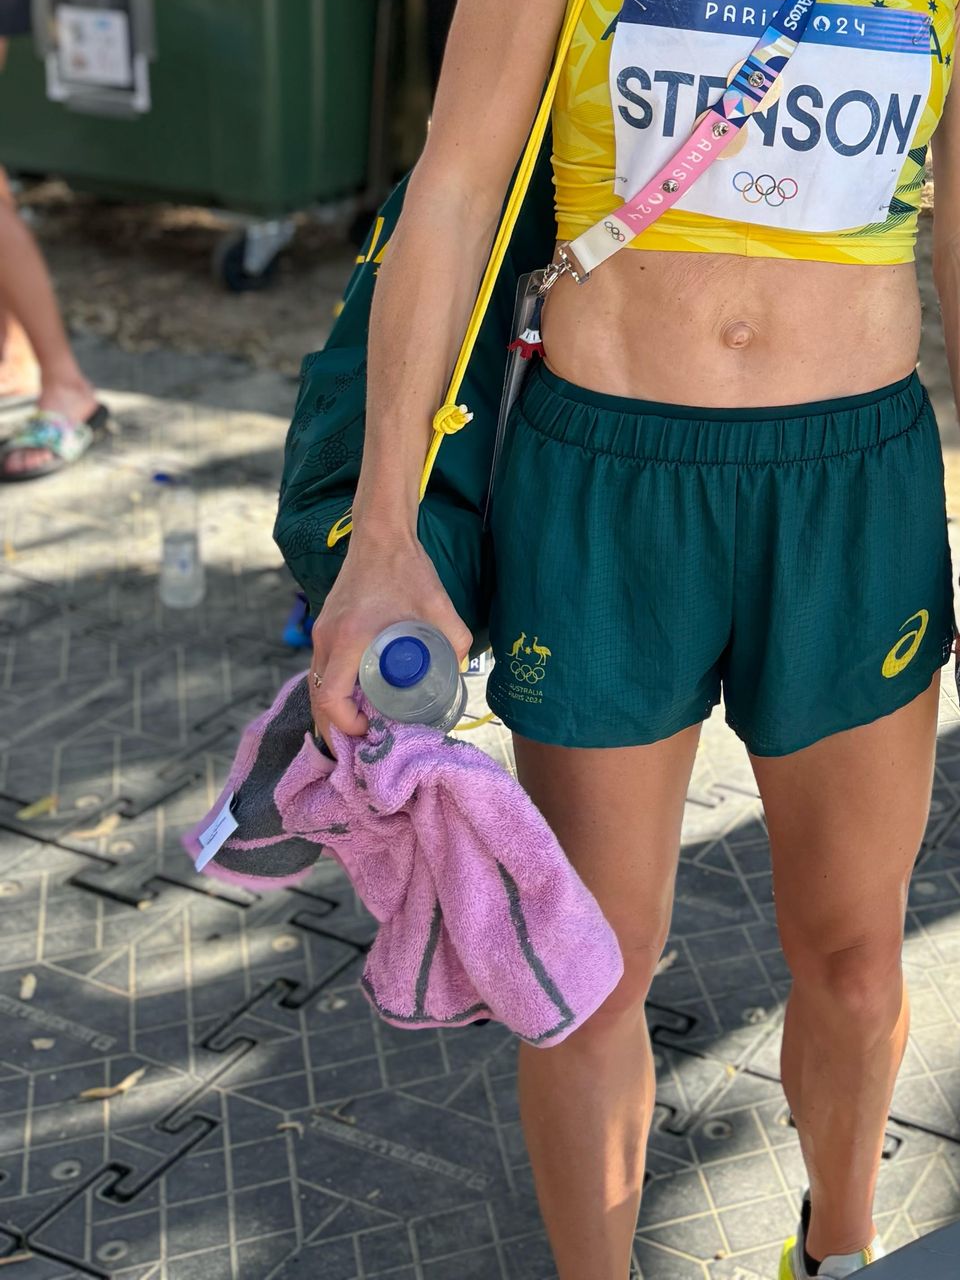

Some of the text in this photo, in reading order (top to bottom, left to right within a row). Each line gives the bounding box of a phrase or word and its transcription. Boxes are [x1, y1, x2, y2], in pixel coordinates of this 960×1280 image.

[705, 2, 865, 36] PARI 024
[628, 123, 723, 220] ARIS 024
[525, 696, 542, 704] 2024
